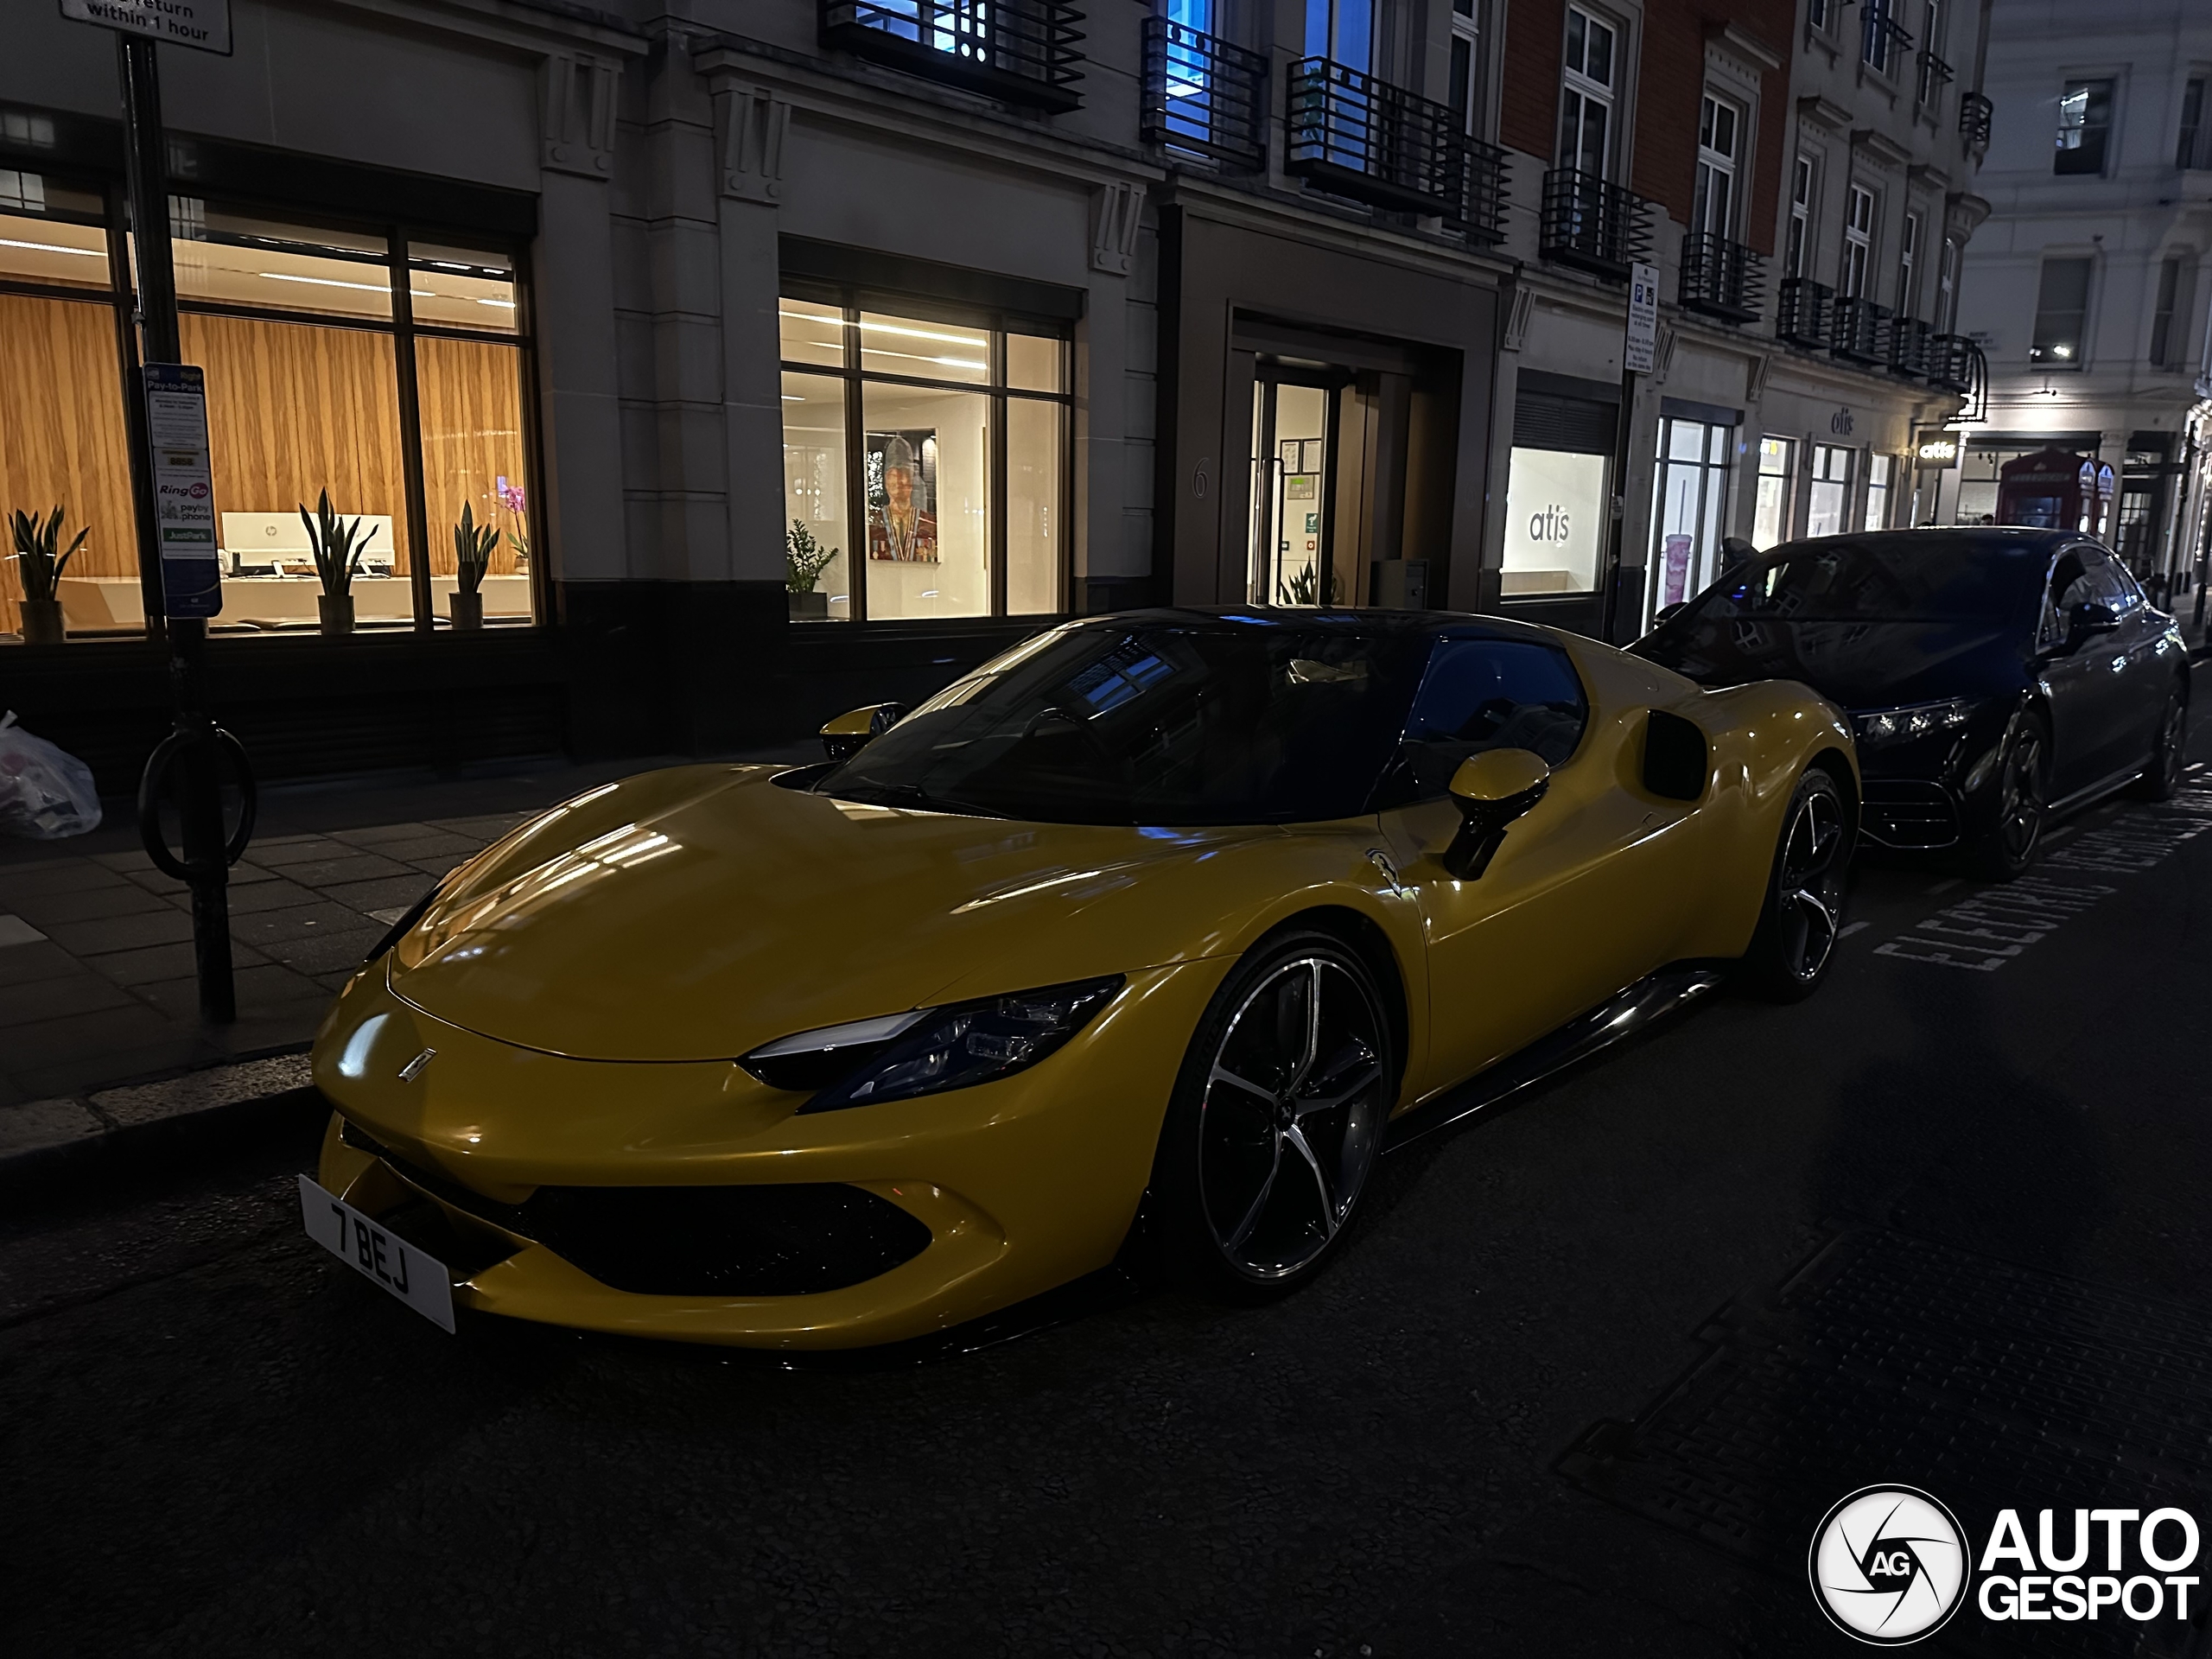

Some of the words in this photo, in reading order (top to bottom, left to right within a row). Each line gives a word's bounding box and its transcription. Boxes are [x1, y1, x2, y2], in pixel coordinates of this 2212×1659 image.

[88, 3, 146, 27] within
[154, 16, 161, 29] 1
[168, 19, 209, 41] hour
[148, 380, 203, 392] Pay-to-Park
[1193, 457, 1209, 499] 6
[1529, 505, 1569, 541] atis
[1872, 875, 2118, 972] ELECTRIC
[331, 1203, 346, 1253] 7
[353, 1217, 409, 1294] BEJ
